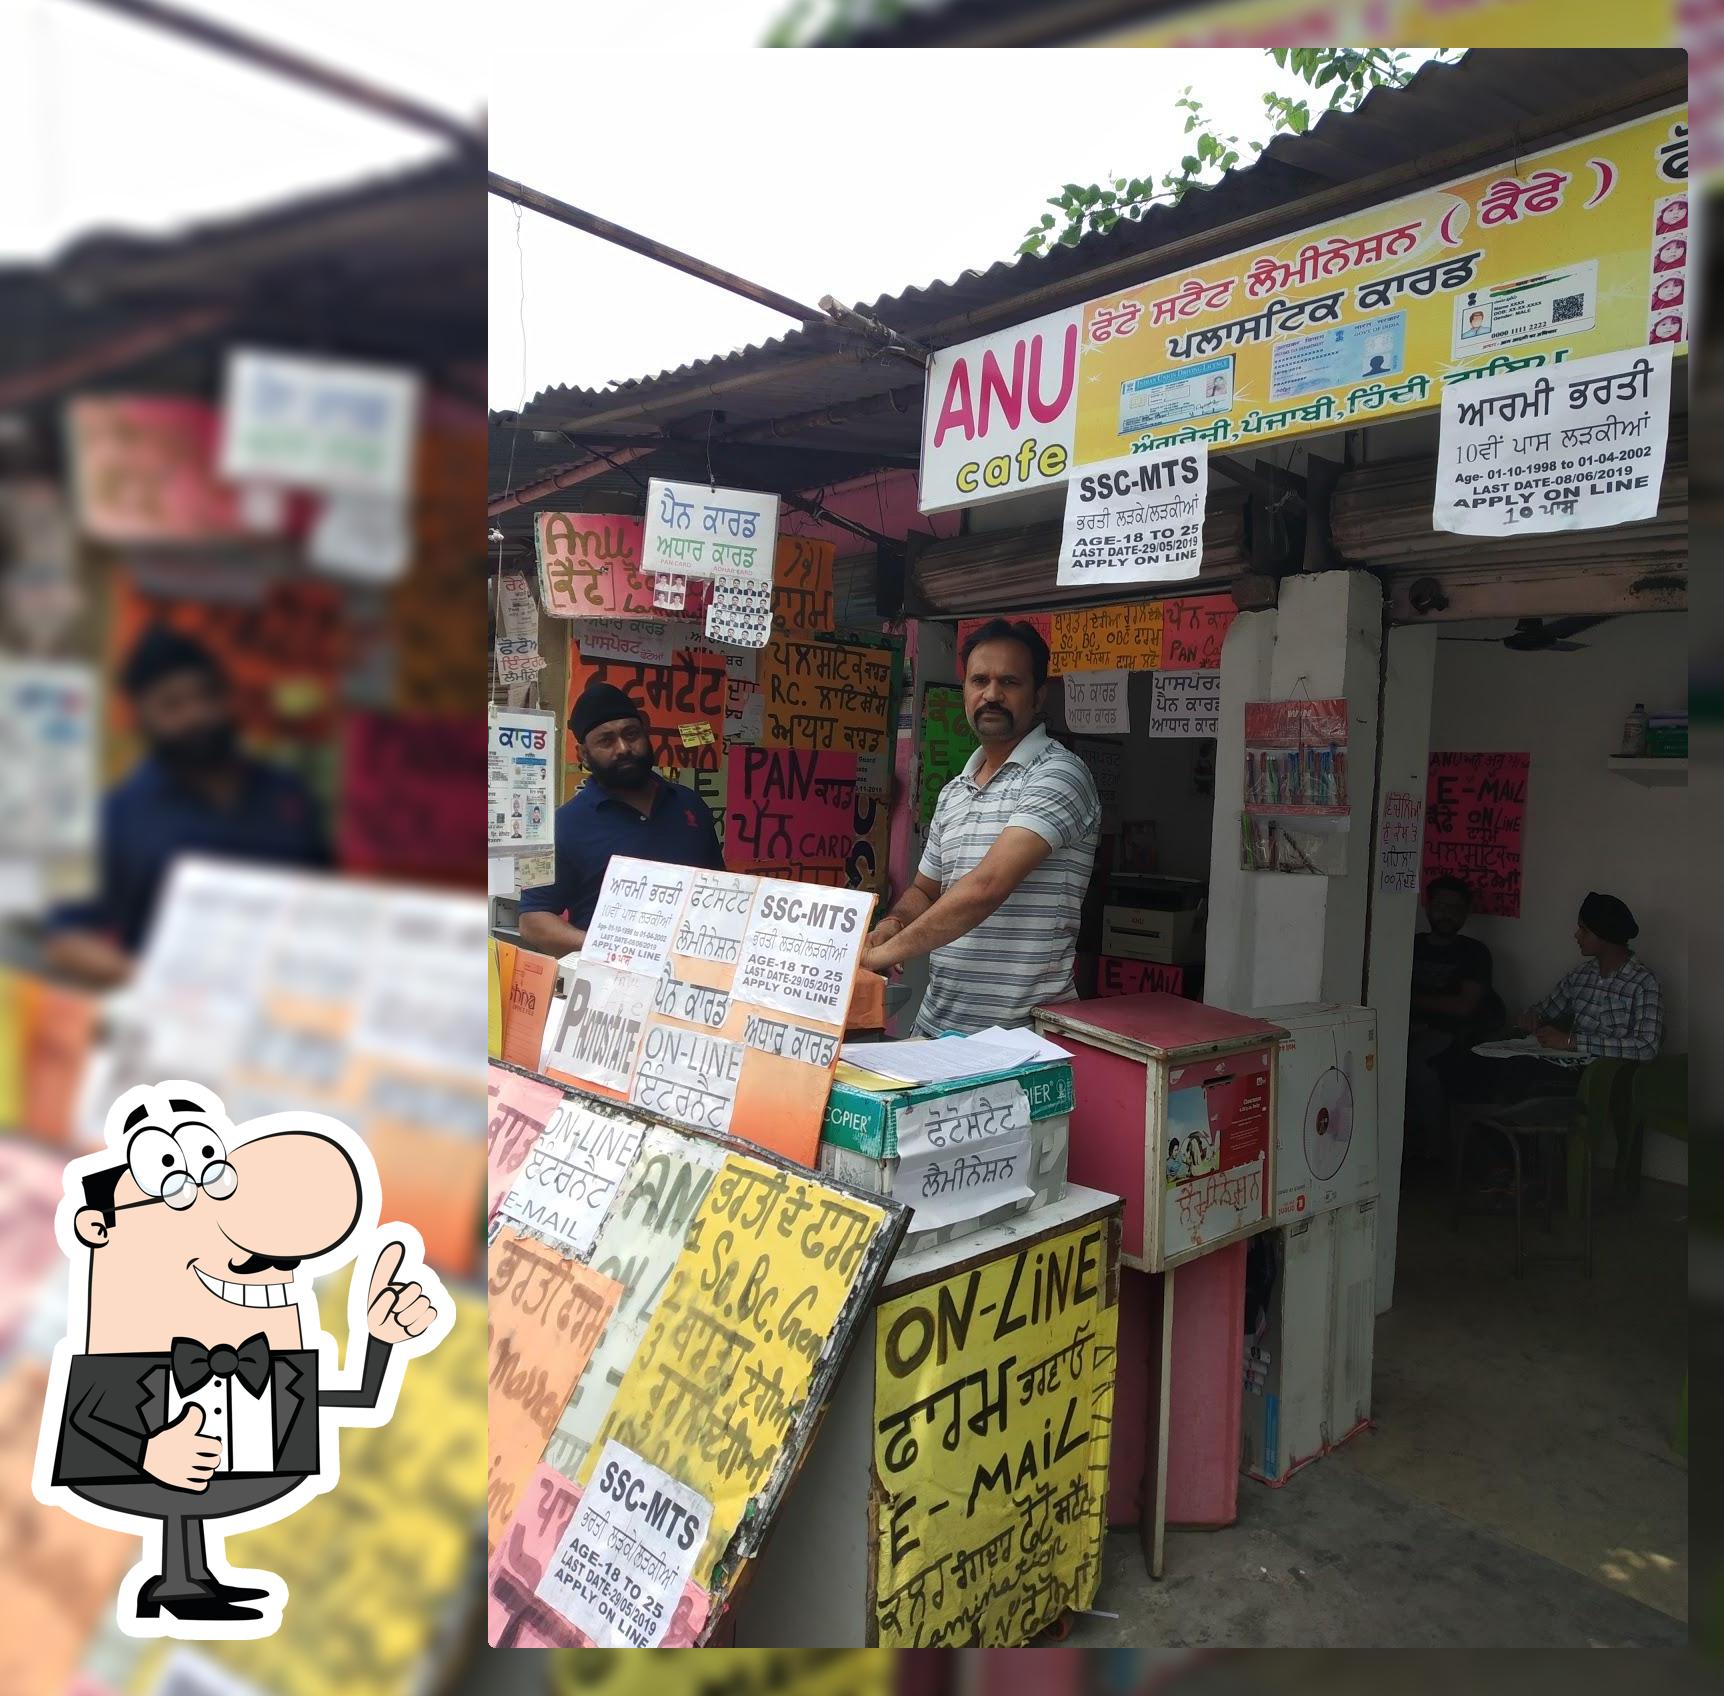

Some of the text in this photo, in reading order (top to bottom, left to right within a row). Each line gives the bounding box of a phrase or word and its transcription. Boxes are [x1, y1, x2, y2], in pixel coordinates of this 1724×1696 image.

[1169, 252, 1481, 358] ਪਲਾਸਟਿਕ ਕਾਰਡ
[934, 323, 1078, 448] ANU
[1457, 377, 1554, 427] ਆਰਮੀ
[1569, 358, 1654, 407] ਭਰਤੀ
[1513, 430, 1551, 456] ਪਾਸ
[1560, 411, 1652, 449] ਲੜਕੀਆਂ
[956, 438, 1068, 493] cafe
[1079, 456, 1199, 502] SSC-MTS
[1455, 446, 1652, 485] Age- 01-10-1998 to 01-04-2002
[1472, 466, 1634, 495] LAST DATE-08/06/2019
[1453, 475, 1650, 509] APPLY ON LINE
[660, 487, 760, 538] ਪੈਨ ਕਾਰਡ
[1076, 507, 1112, 530] ਭਰਤੀ
[657, 535, 705, 561] ਅਧਾਰ
[712, 543, 757, 568] ਕਾਰਡ
[1072, 536, 1198, 558] LAST DATE-29/05/2019
[1074, 524, 1200, 547] AGE-18 TO 25
[1071, 549, 1197, 569] APPLY ON LINE
[1157, 691, 1179, 713] ਪੈਨ
[499, 726, 547, 750] ਕਾਰਡ
[744, 748, 818, 801] PAN
[800, 833, 852, 858] CARD
[610, 875, 683, 906] ਆਰਮੀ ਭਰਤੀ
[760, 894, 858, 933] SSC-MTS
[592, 940, 662, 961] APPLY ON LINE
[747, 953, 843, 983] AGE-18 TO 25
[742, 977, 838, 1008] APPLY ON LINE
[744, 965, 841, 995] LAST DATE-29/05/2019
[684, 982, 731, 1027] ਕਾਰਡ
[645, 1026, 740, 1082] ON-LINE
[791, 1027, 840, 1067] ਕਾਰਡ
[541, 1104, 639, 1168] ON-LINE
[503, 1190, 580, 1242] E-MAIL
[599, 1461, 700, 1551] SSC-MTS
[560, 1550, 657, 1637] LAST DATE-29/05/2019
[569, 1537, 665, 1620] AGE-18 TO 25
[554, 1568, 649, 1649] APPLY ON LINE
